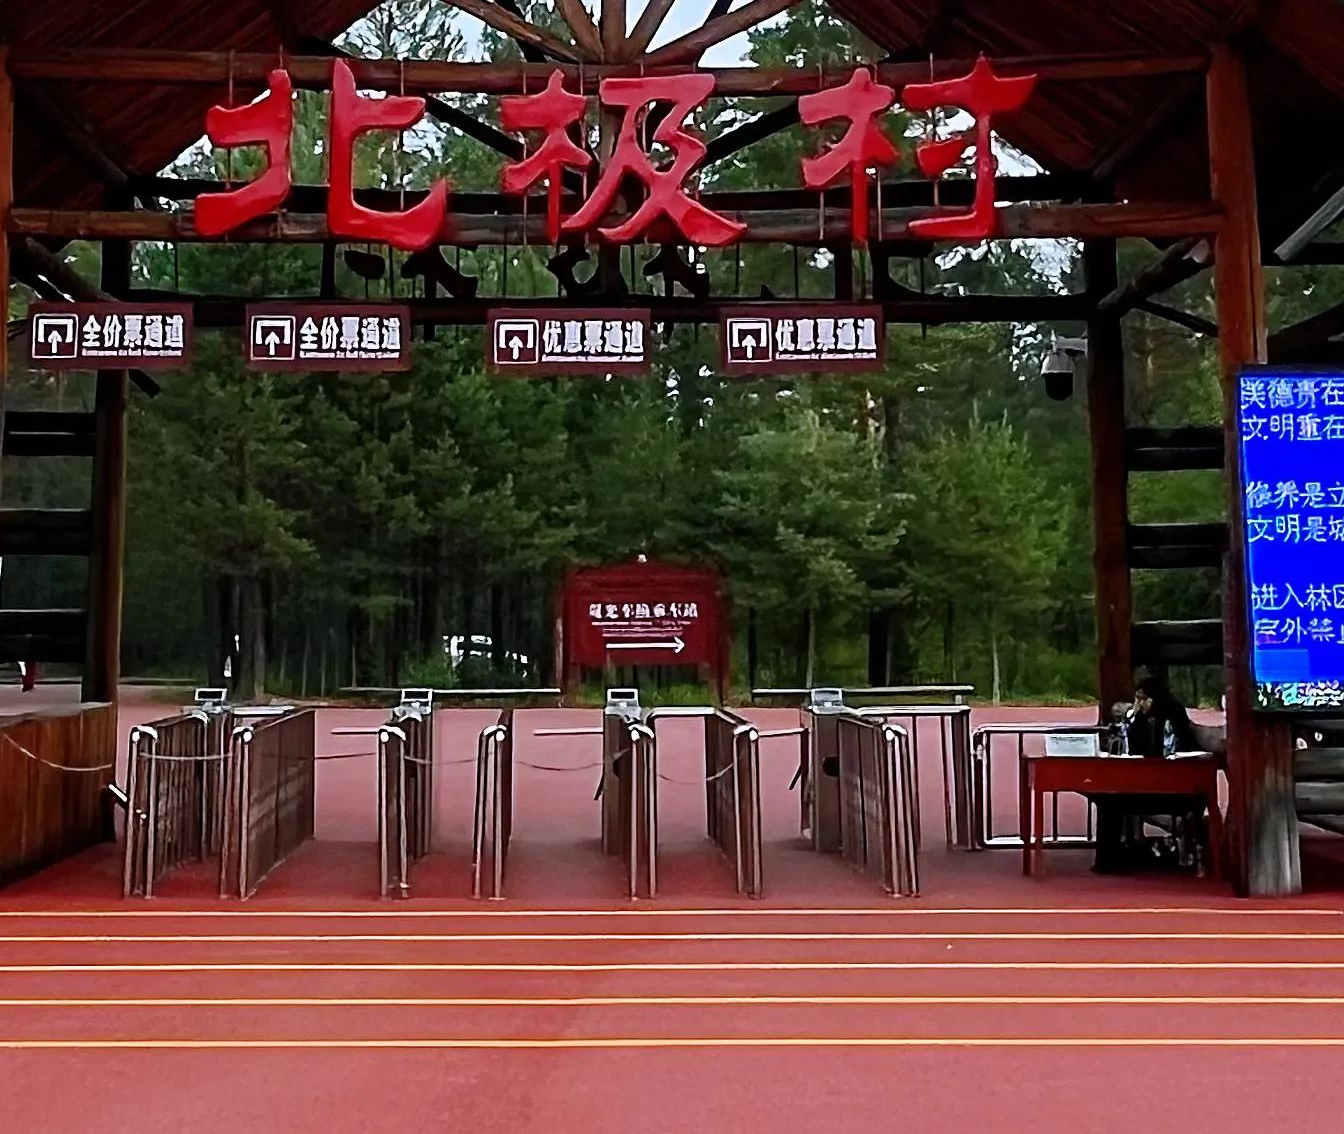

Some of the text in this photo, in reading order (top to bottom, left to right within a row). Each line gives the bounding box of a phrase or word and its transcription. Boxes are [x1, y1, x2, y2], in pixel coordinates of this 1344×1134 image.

[194, 55, 1038, 251] 北极村
[82, 315, 183, 348] 全价票通道
[300, 317, 400, 350] 全价票通道
[543, 321, 643, 353] 优惠票通道
[775, 318, 876, 351] 优惠票通道
